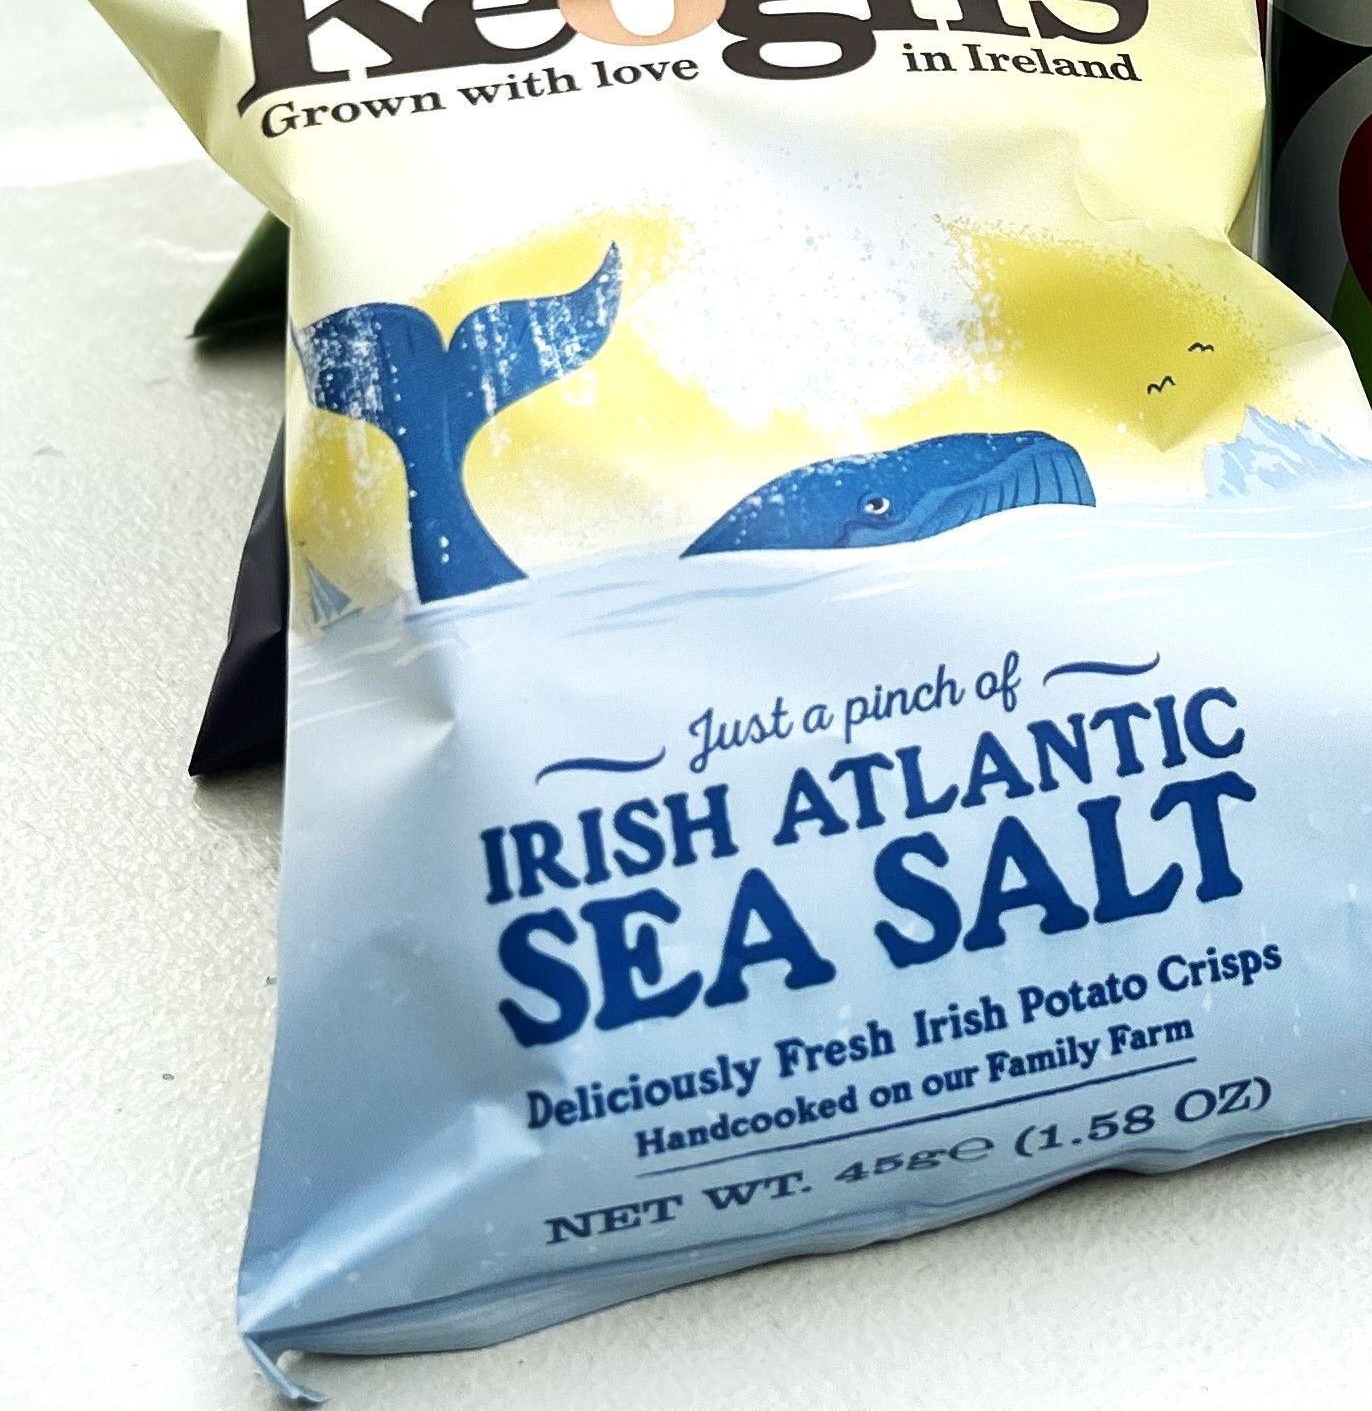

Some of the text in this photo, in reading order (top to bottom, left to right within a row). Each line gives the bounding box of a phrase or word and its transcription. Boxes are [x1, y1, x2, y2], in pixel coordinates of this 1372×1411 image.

[259, 56, 700, 140] Grown with love
[900, 42, 1142, 83] in Ireland
[687, 650, 1022, 772] Just a pinch of
[480, 686, 1246, 905] IRISH ATLANTIC
[497, 770, 1257, 1049] SEA SALT
[525, 939, 1283, 1131] Deliciously Fresh Irish Potato Crisps
[635, 1017, 1195, 1159] Handcooked on our Family Farm
[545, 1194, 683, 1246] NET
[699, 1170, 812, 1212] WT.
[1014, 1105, 1157, 1160] (1.58
[1174, 1076, 1274, 1129] OZ)
